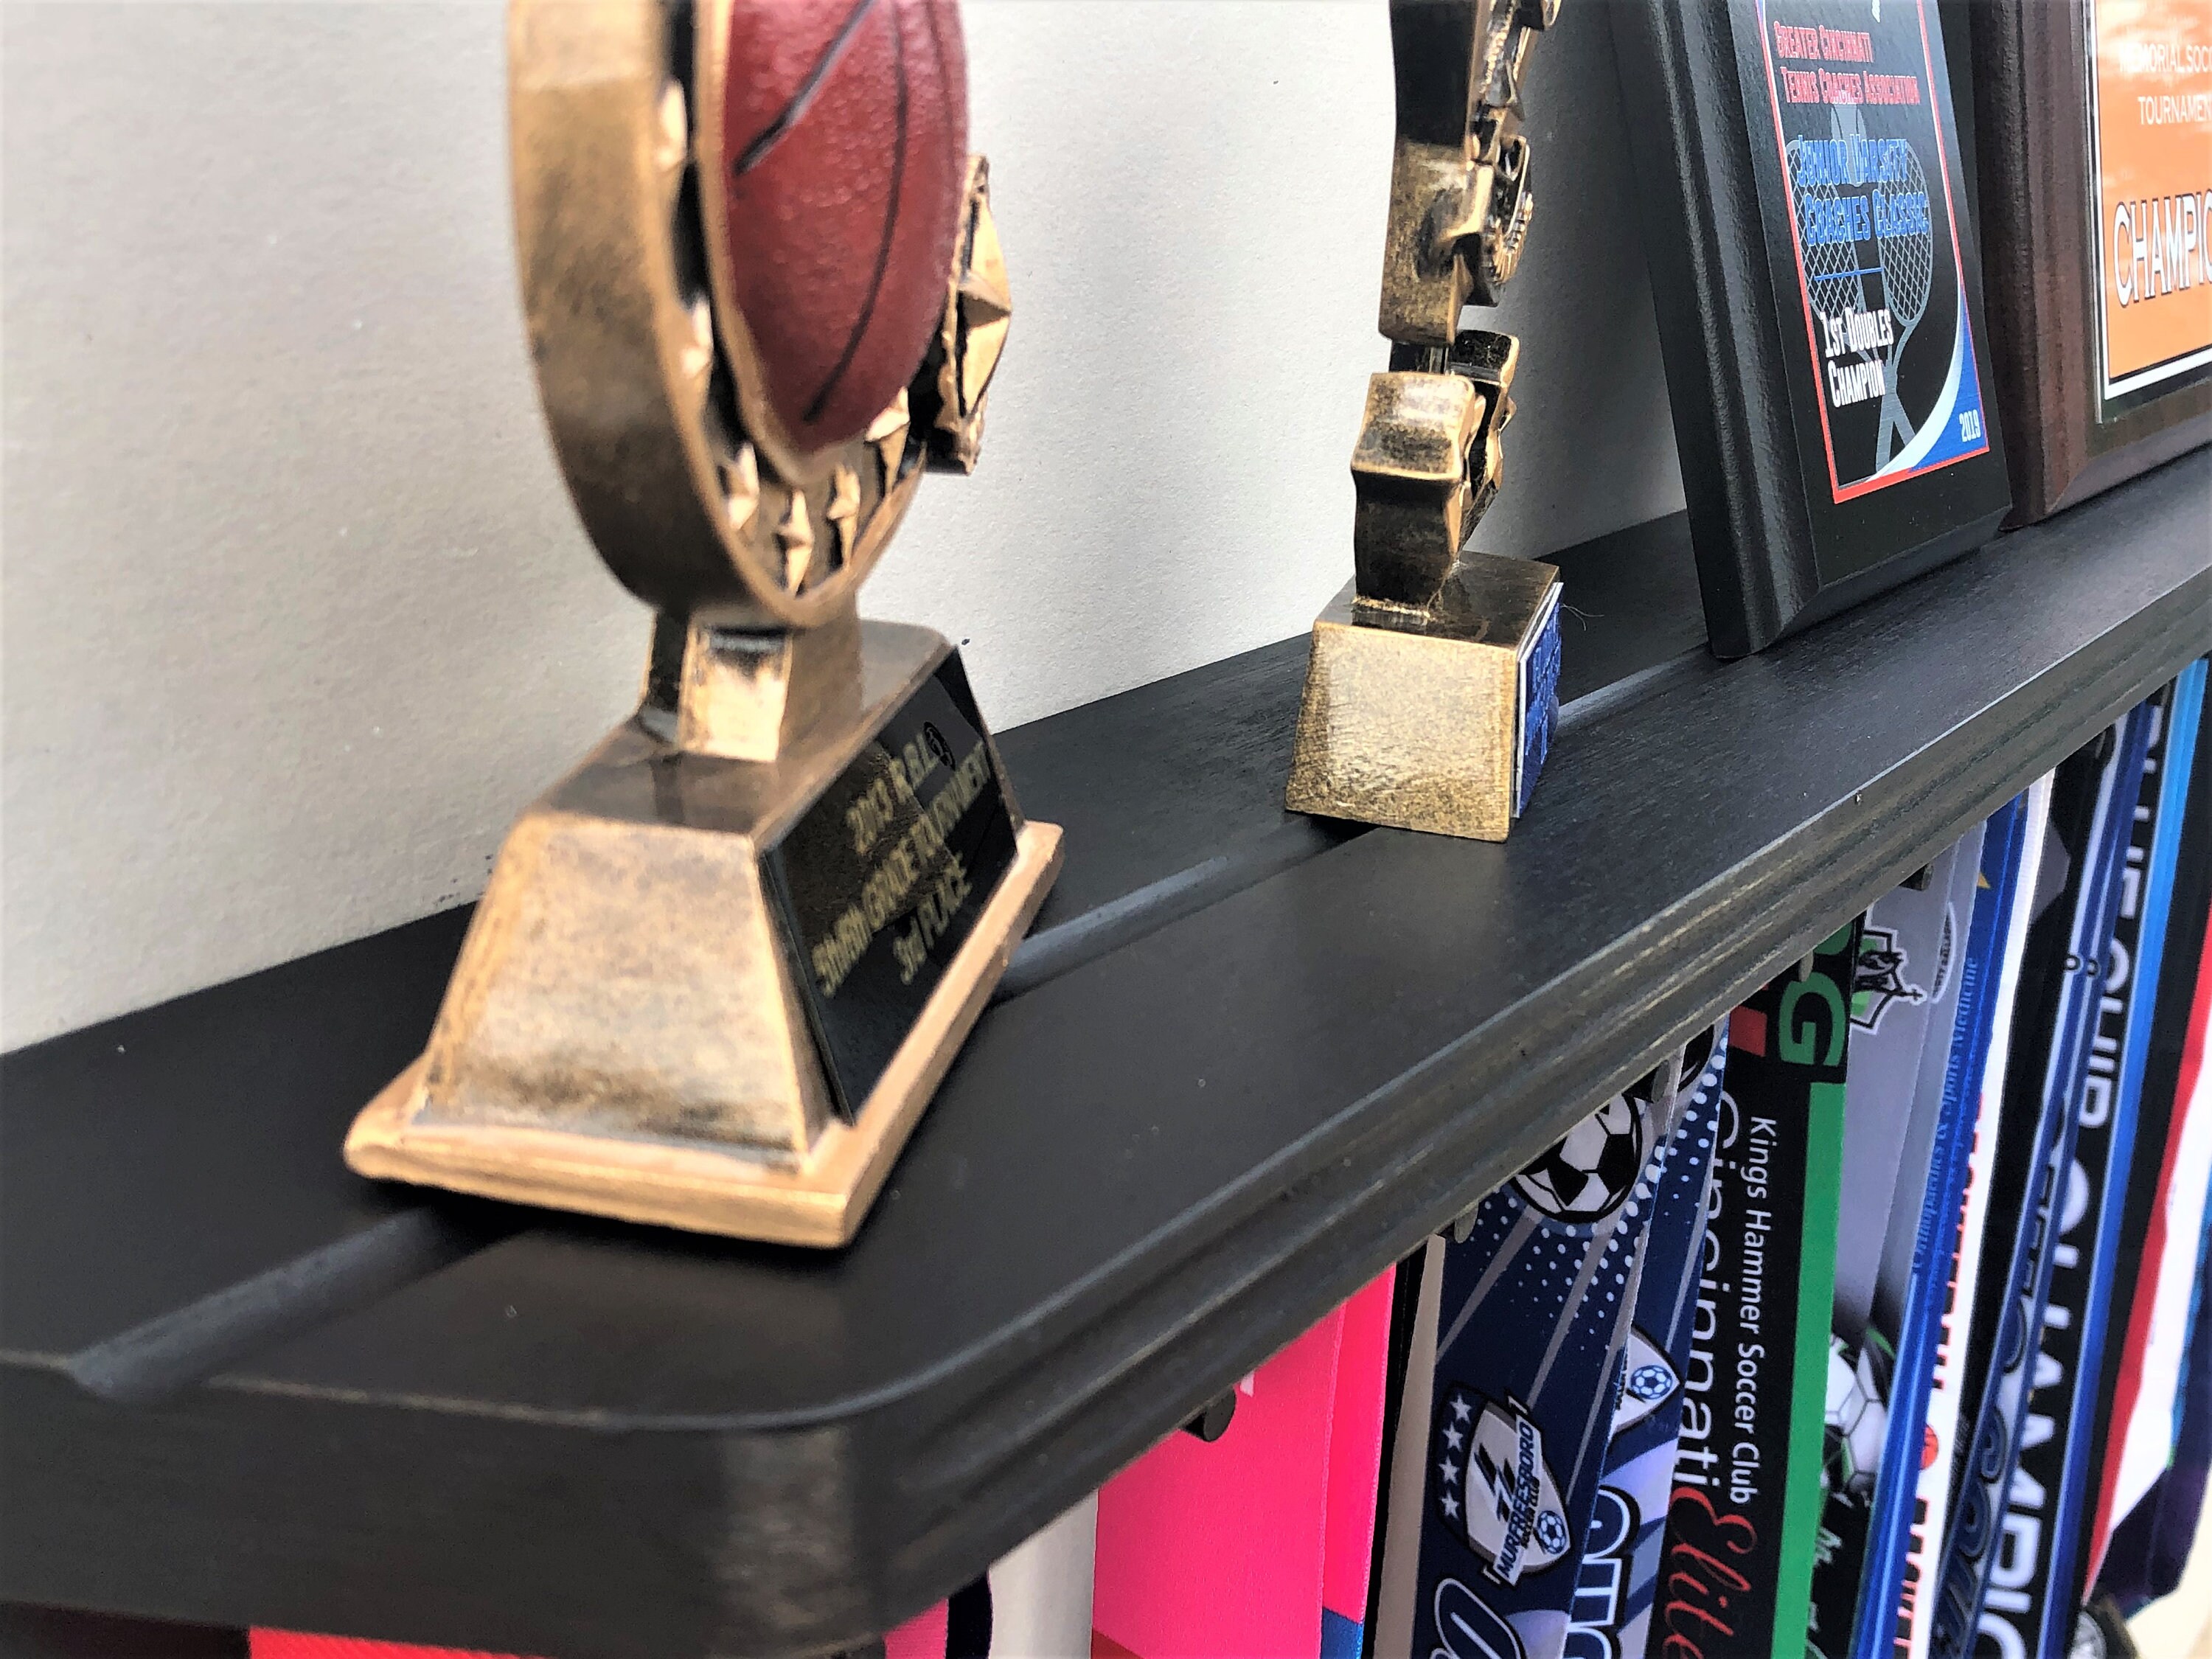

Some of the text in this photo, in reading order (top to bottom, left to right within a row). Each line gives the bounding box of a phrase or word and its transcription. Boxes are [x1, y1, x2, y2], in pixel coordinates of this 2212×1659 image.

[1773, 21, 1874, 63] GREATER CINCINNATI
[2118, 42, 2185, 73] MEMORIAL
[1780, 66, 1921, 105] TENNIS COACHES ASSOCIATION
[1797, 133, 1907, 187] JUNIOR VARSITY
[1804, 189, 1930, 246] COACHES CLASSIC
[1820, 307, 1894, 358] 1ST DOUBLES
[1827, 359, 1885, 408] CHAMPION
[1958, 409, 1982, 442] 2019
[1728, 1116, 1778, 1505] Kings Hammer Soccer Club
[1662, 1091, 1758, 1659] innati Elite
[1497, 1421, 1534, 1579] MURFREESBORO
